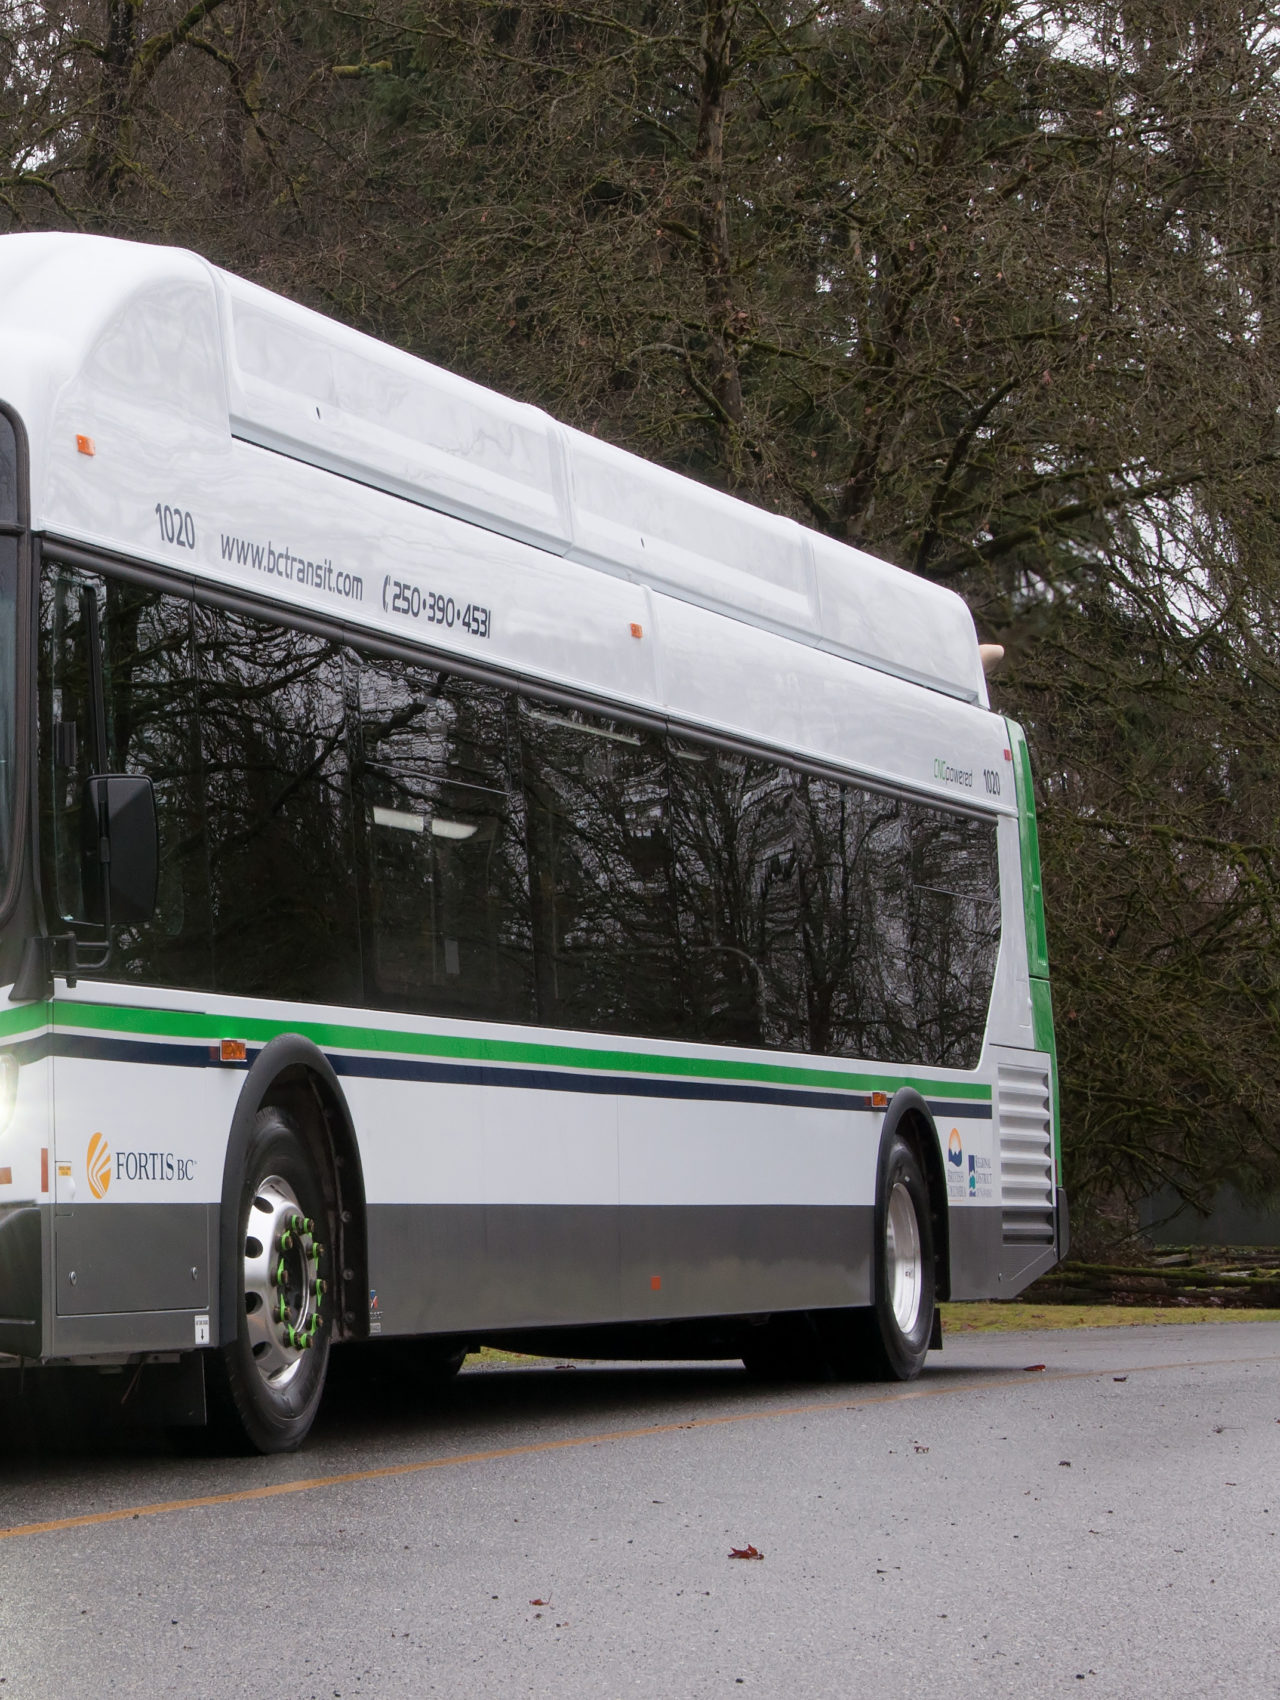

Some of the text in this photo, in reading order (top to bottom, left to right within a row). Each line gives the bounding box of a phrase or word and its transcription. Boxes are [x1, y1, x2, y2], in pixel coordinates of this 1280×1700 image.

[155, 503, 195, 550] 1020
[221, 533, 363, 601] www.bctransit.com
[983, 768, 1001, 796] 1020
